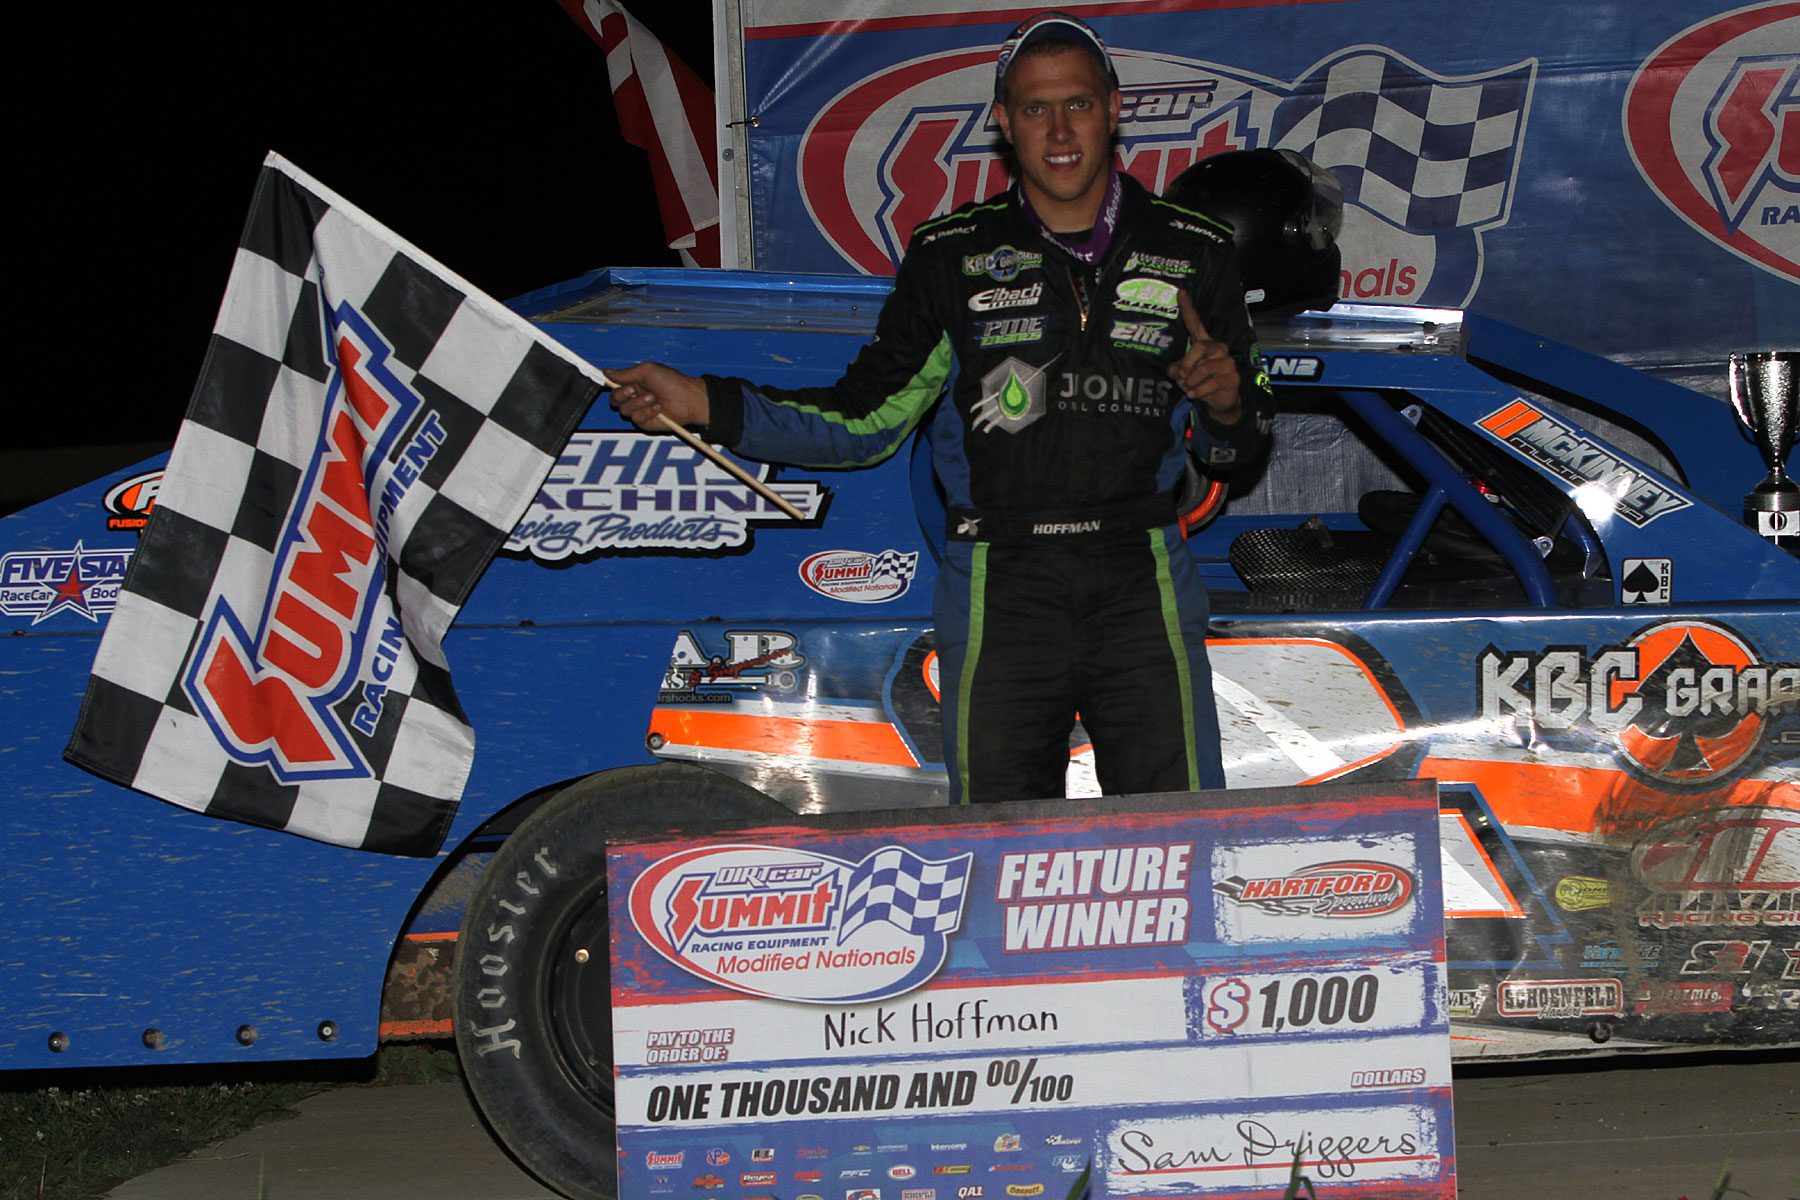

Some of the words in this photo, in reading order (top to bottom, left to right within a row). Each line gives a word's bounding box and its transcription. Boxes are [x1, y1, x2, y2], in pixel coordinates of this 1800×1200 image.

[968, 283, 1043, 311] Eibach
[1059, 372, 1173, 404] JONES
[1058, 402, 1090, 412] OIL
[533, 489, 810, 512] ACHINE
[587, 513, 740, 545] Products
[1033, 520, 1100, 535] HOFFMAN
[2, 557, 71, 588] FIVE
[80, 554, 128, 578] STA
[0, 589, 52, 601] RaceCar
[351, 617, 406, 735] RACIN
[1481, 649, 1645, 729] KBC
[998, 843, 1192, 900] FEATURE
[1240, 873, 1395, 900] HARTFORD
[1004, 899, 1190, 952] WINNER
[470, 847, 557, 1059] Hoosier
[691, 940, 743, 953] RACING
[747, 936, 829, 951] EQUIPMENT
[716, 949, 809, 975] Modified
[816, 946, 916, 969] Nationals
[1207, 977, 1251, 1033] $
[1260, 974, 1379, 1032] 1,000
[1504, 986, 1616, 1010] SCHOENFELD
[911, 999, 1058, 1043] Hoffman
[647, 1031, 678, 1048] PAY
[678, 1030, 700, 1046] TO
[701, 1028, 734, 1045] THE
[646, 1047, 700, 1064] ORDER
[702, 1045, 729, 1062] OF:
[1351, 1068, 1427, 1088] DOLLARS
[646, 1083, 712, 1123] ONE
[720, 1074, 902, 1120] THOUSAND
[903, 1070, 978, 1110] AND
[1118, 1130, 1231, 1175] Sam
[1236, 1120, 1417, 1178] Driggers
[957, 1186, 983, 1199] QA1
